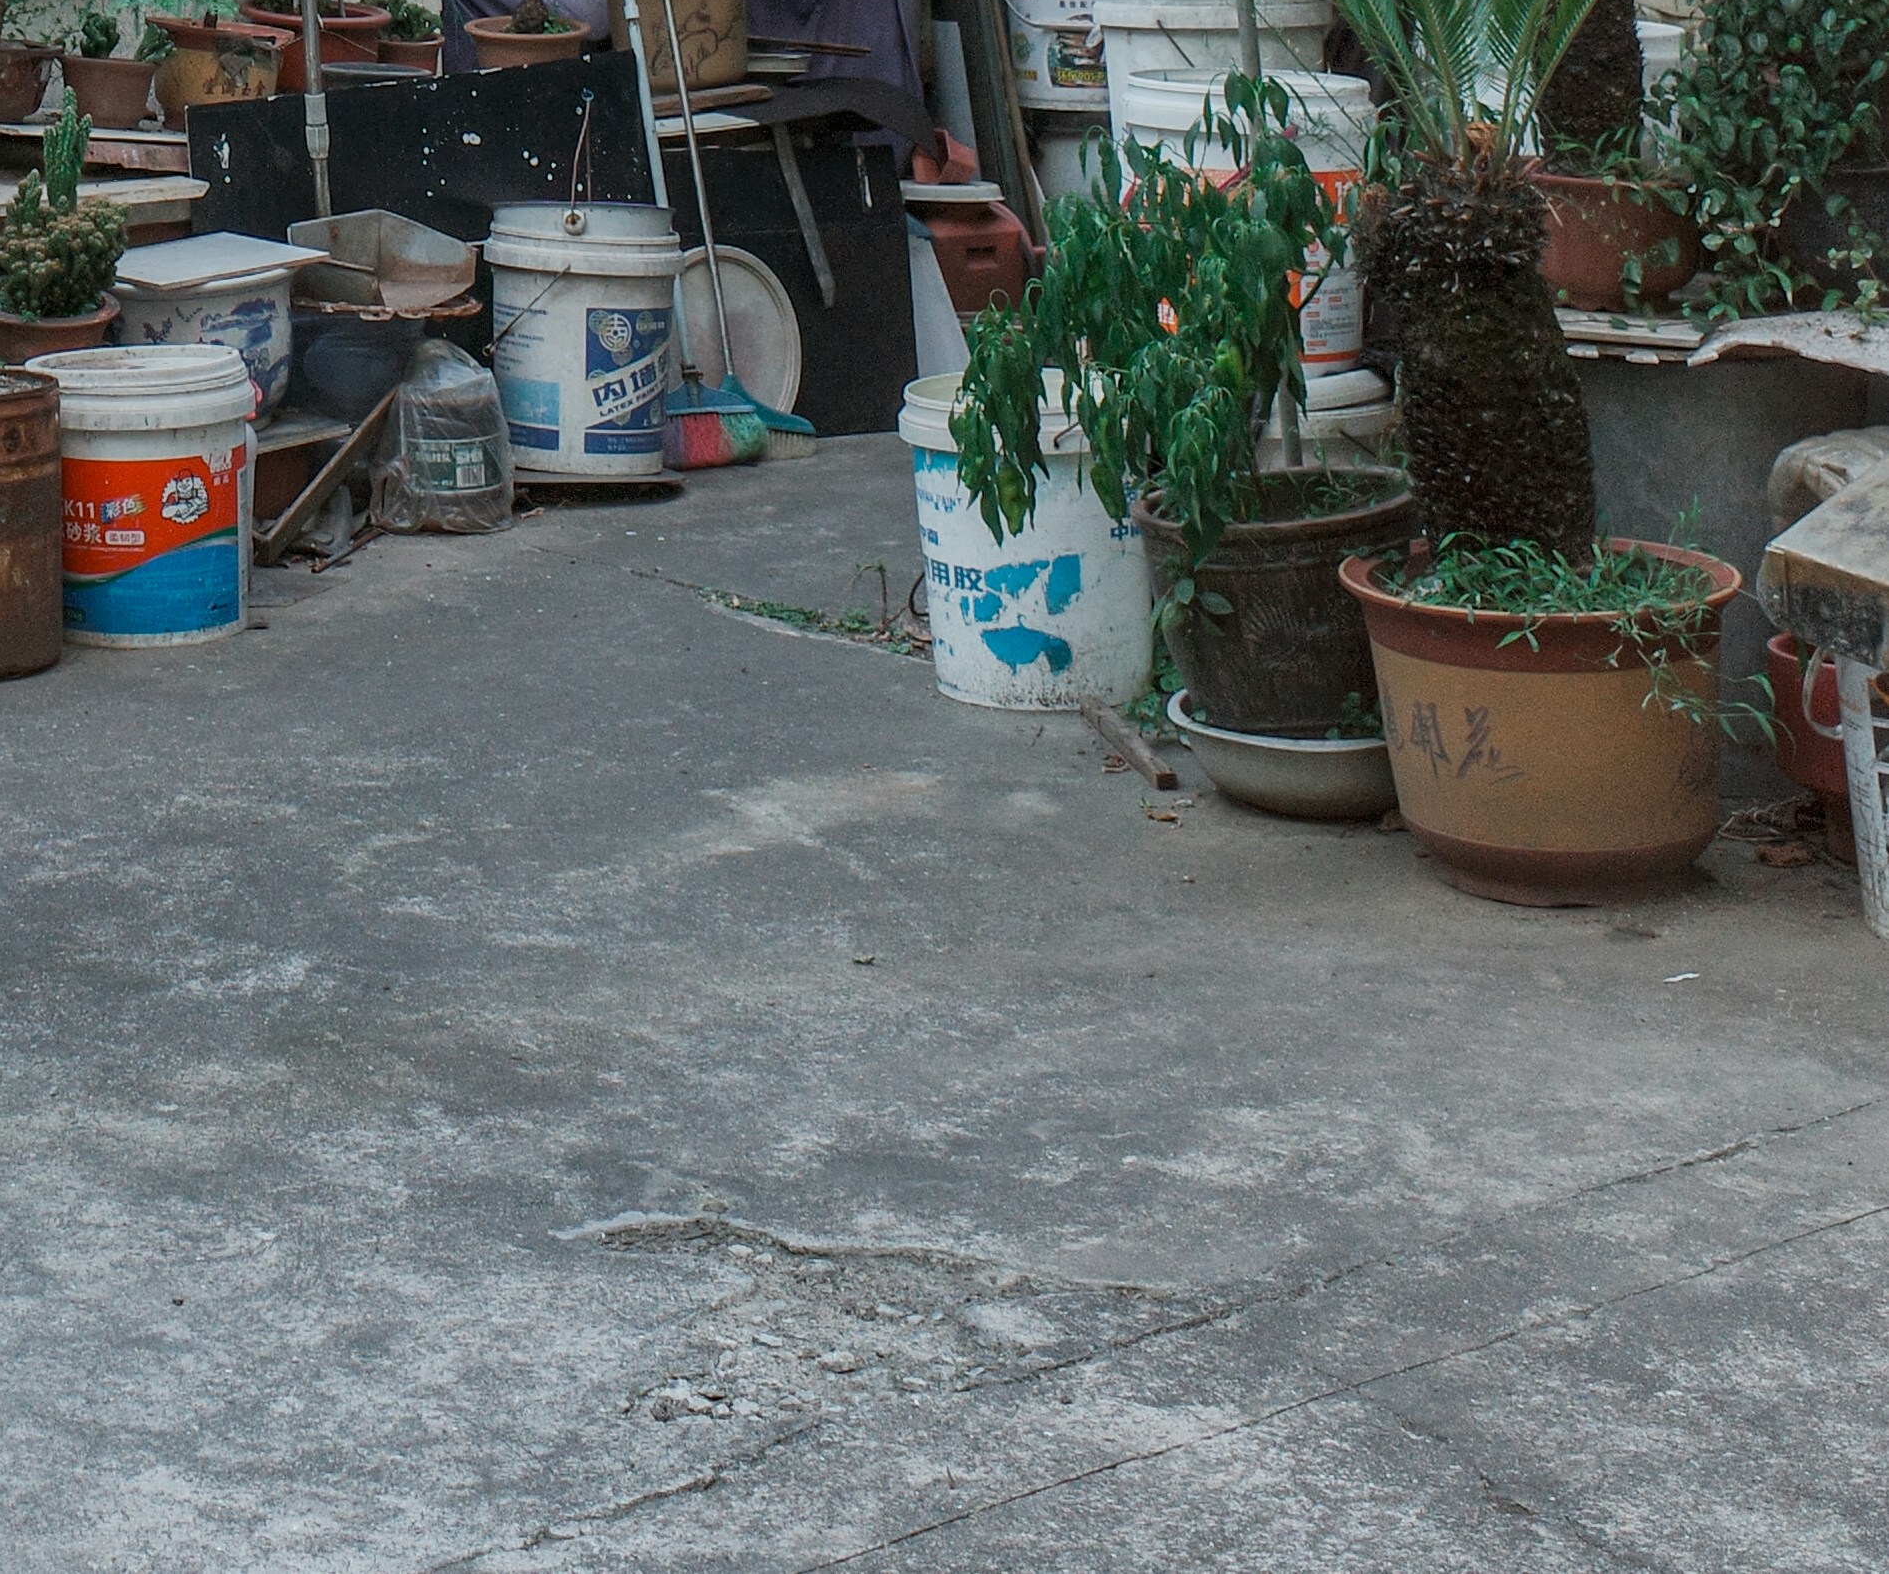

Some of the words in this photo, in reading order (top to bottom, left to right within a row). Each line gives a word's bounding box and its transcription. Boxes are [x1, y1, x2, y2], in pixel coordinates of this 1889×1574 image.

[599, 398, 634, 418] LATEX
[105, 498, 136, 519] 彩色
[62, 521, 103, 544] 砂浆
[922, 554, 985, 593] 用胶
